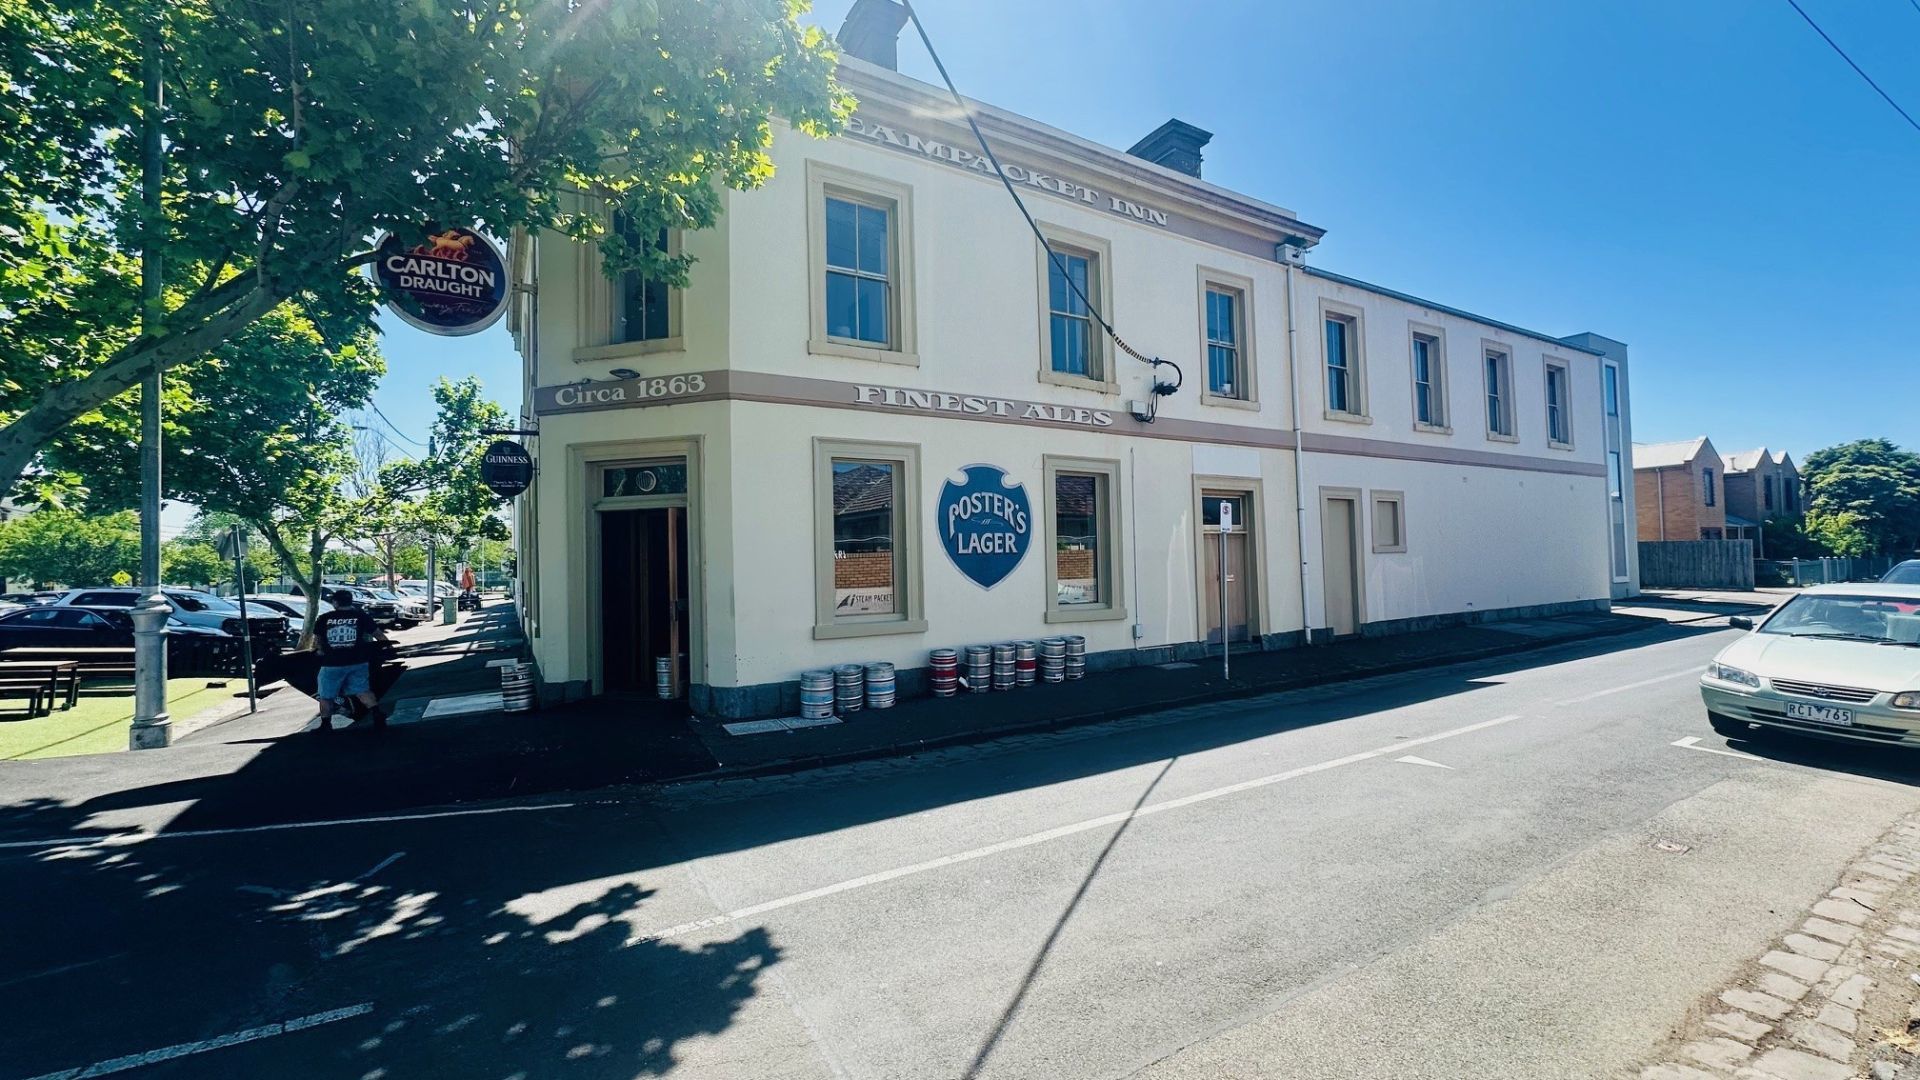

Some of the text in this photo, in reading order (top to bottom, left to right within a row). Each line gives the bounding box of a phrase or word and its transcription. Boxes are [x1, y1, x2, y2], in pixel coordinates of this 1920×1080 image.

[849, 117, 1168, 226] EAMPACKET INN
[386, 255, 495, 287] CARLTON
[400, 275, 483, 298] DRAUGHT
[555, 374, 706, 406] Circa 1863
[853, 384, 1114, 427] FINEST ALES
[485, 454, 528, 464] GUINNESS
[958, 532, 1018, 554] LAGER
[1824, 709, 1849, 722] 765
